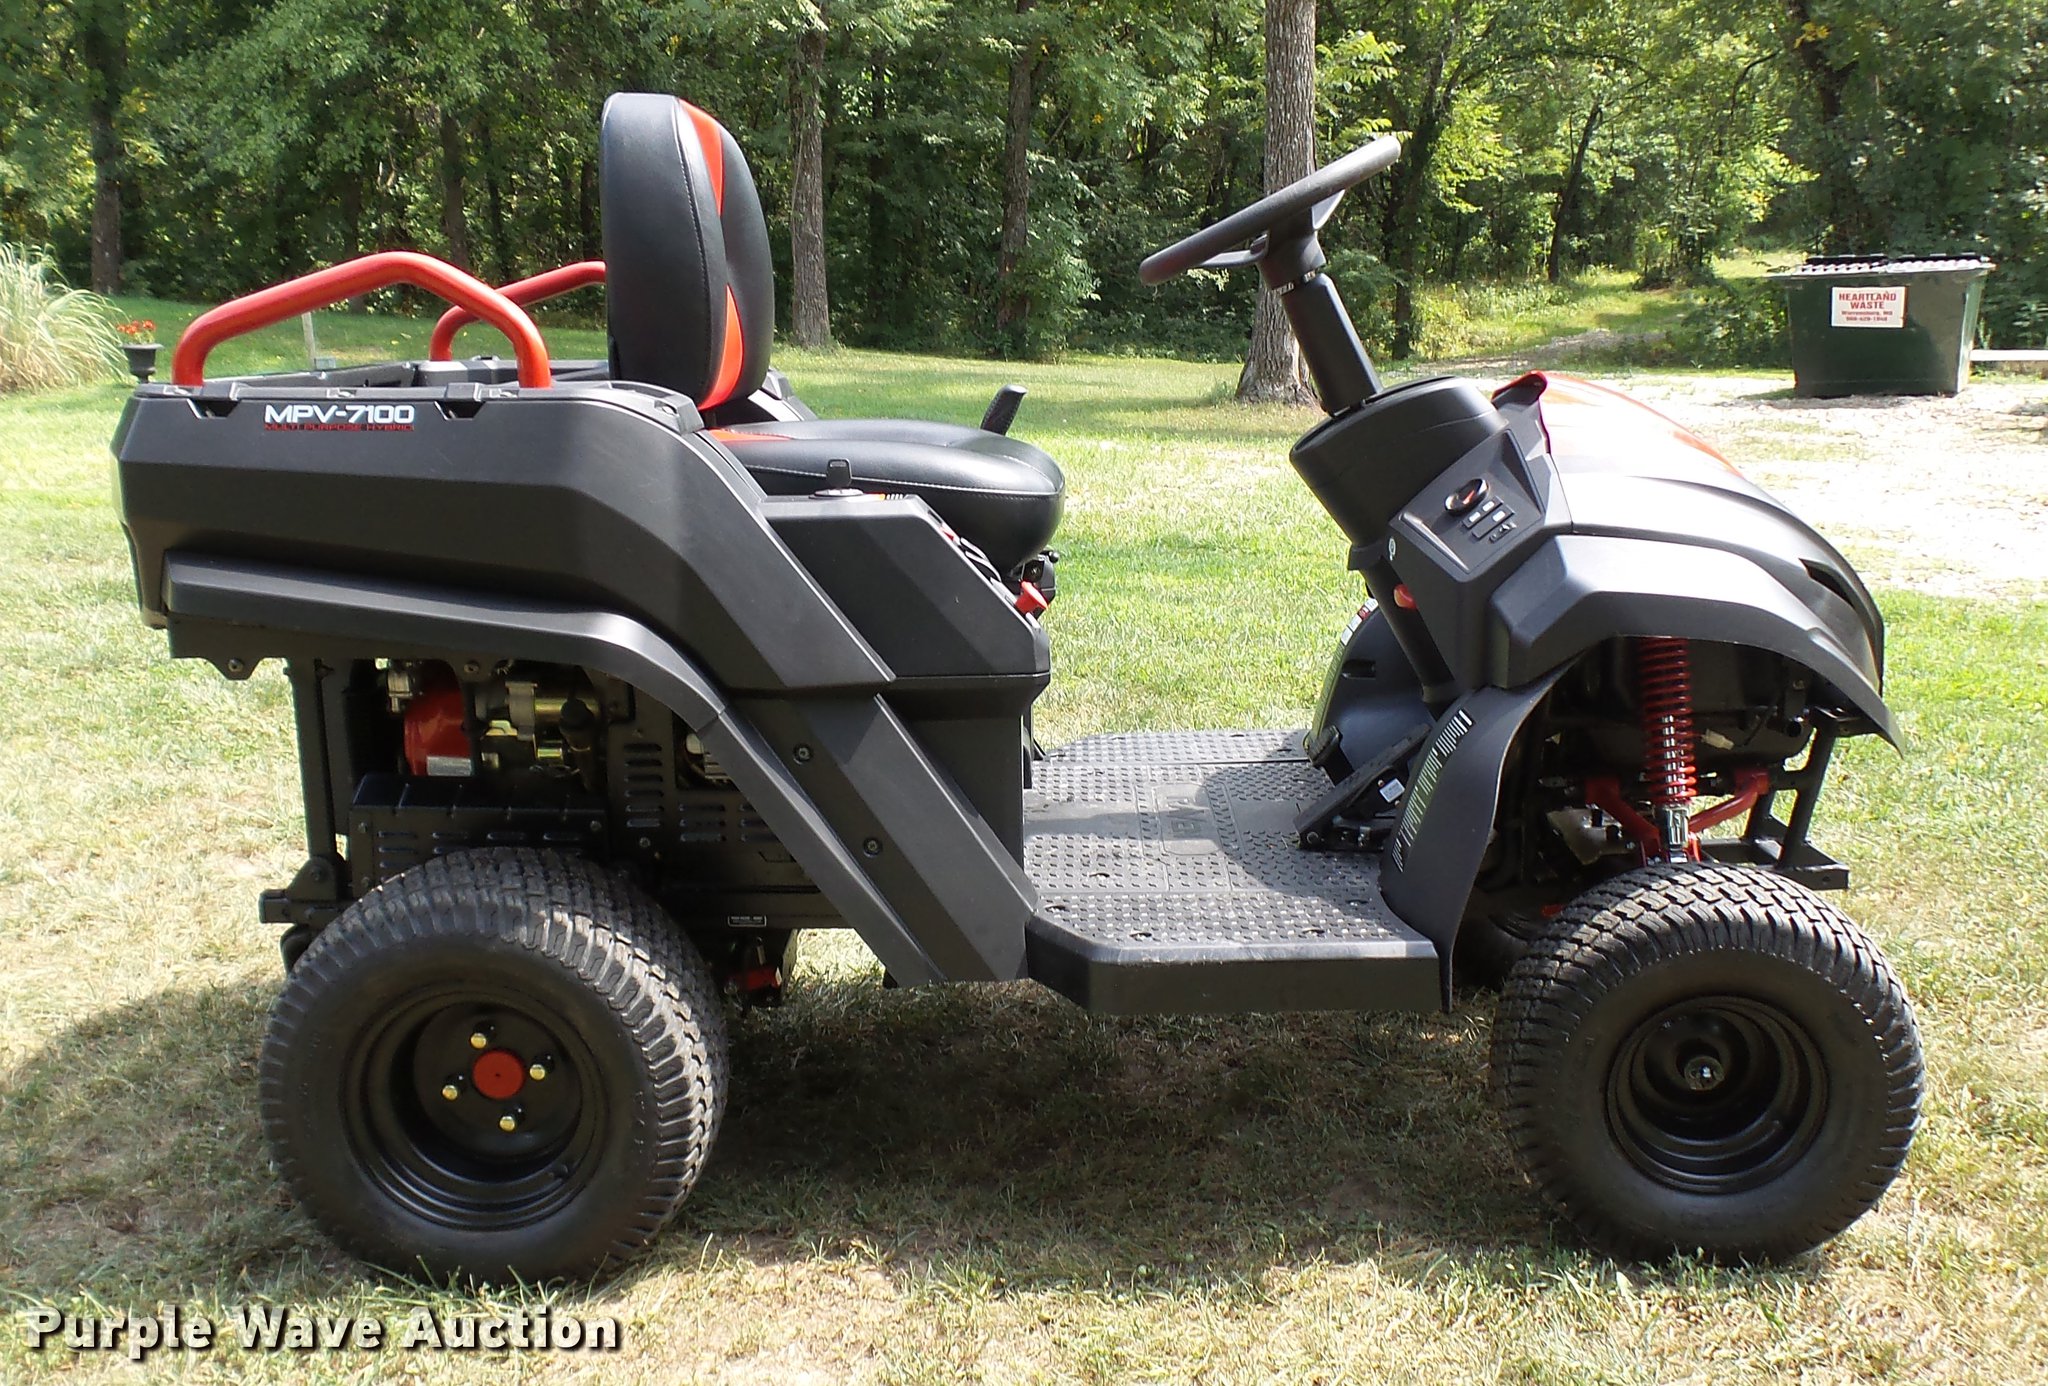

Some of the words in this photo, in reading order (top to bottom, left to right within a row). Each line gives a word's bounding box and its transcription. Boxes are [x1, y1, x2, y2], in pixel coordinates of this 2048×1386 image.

[1839, 293, 1896, 301] HEARTLAND
[1850, 301, 1884, 309] WASTE
[264, 404, 415, 423] MPV-7100
